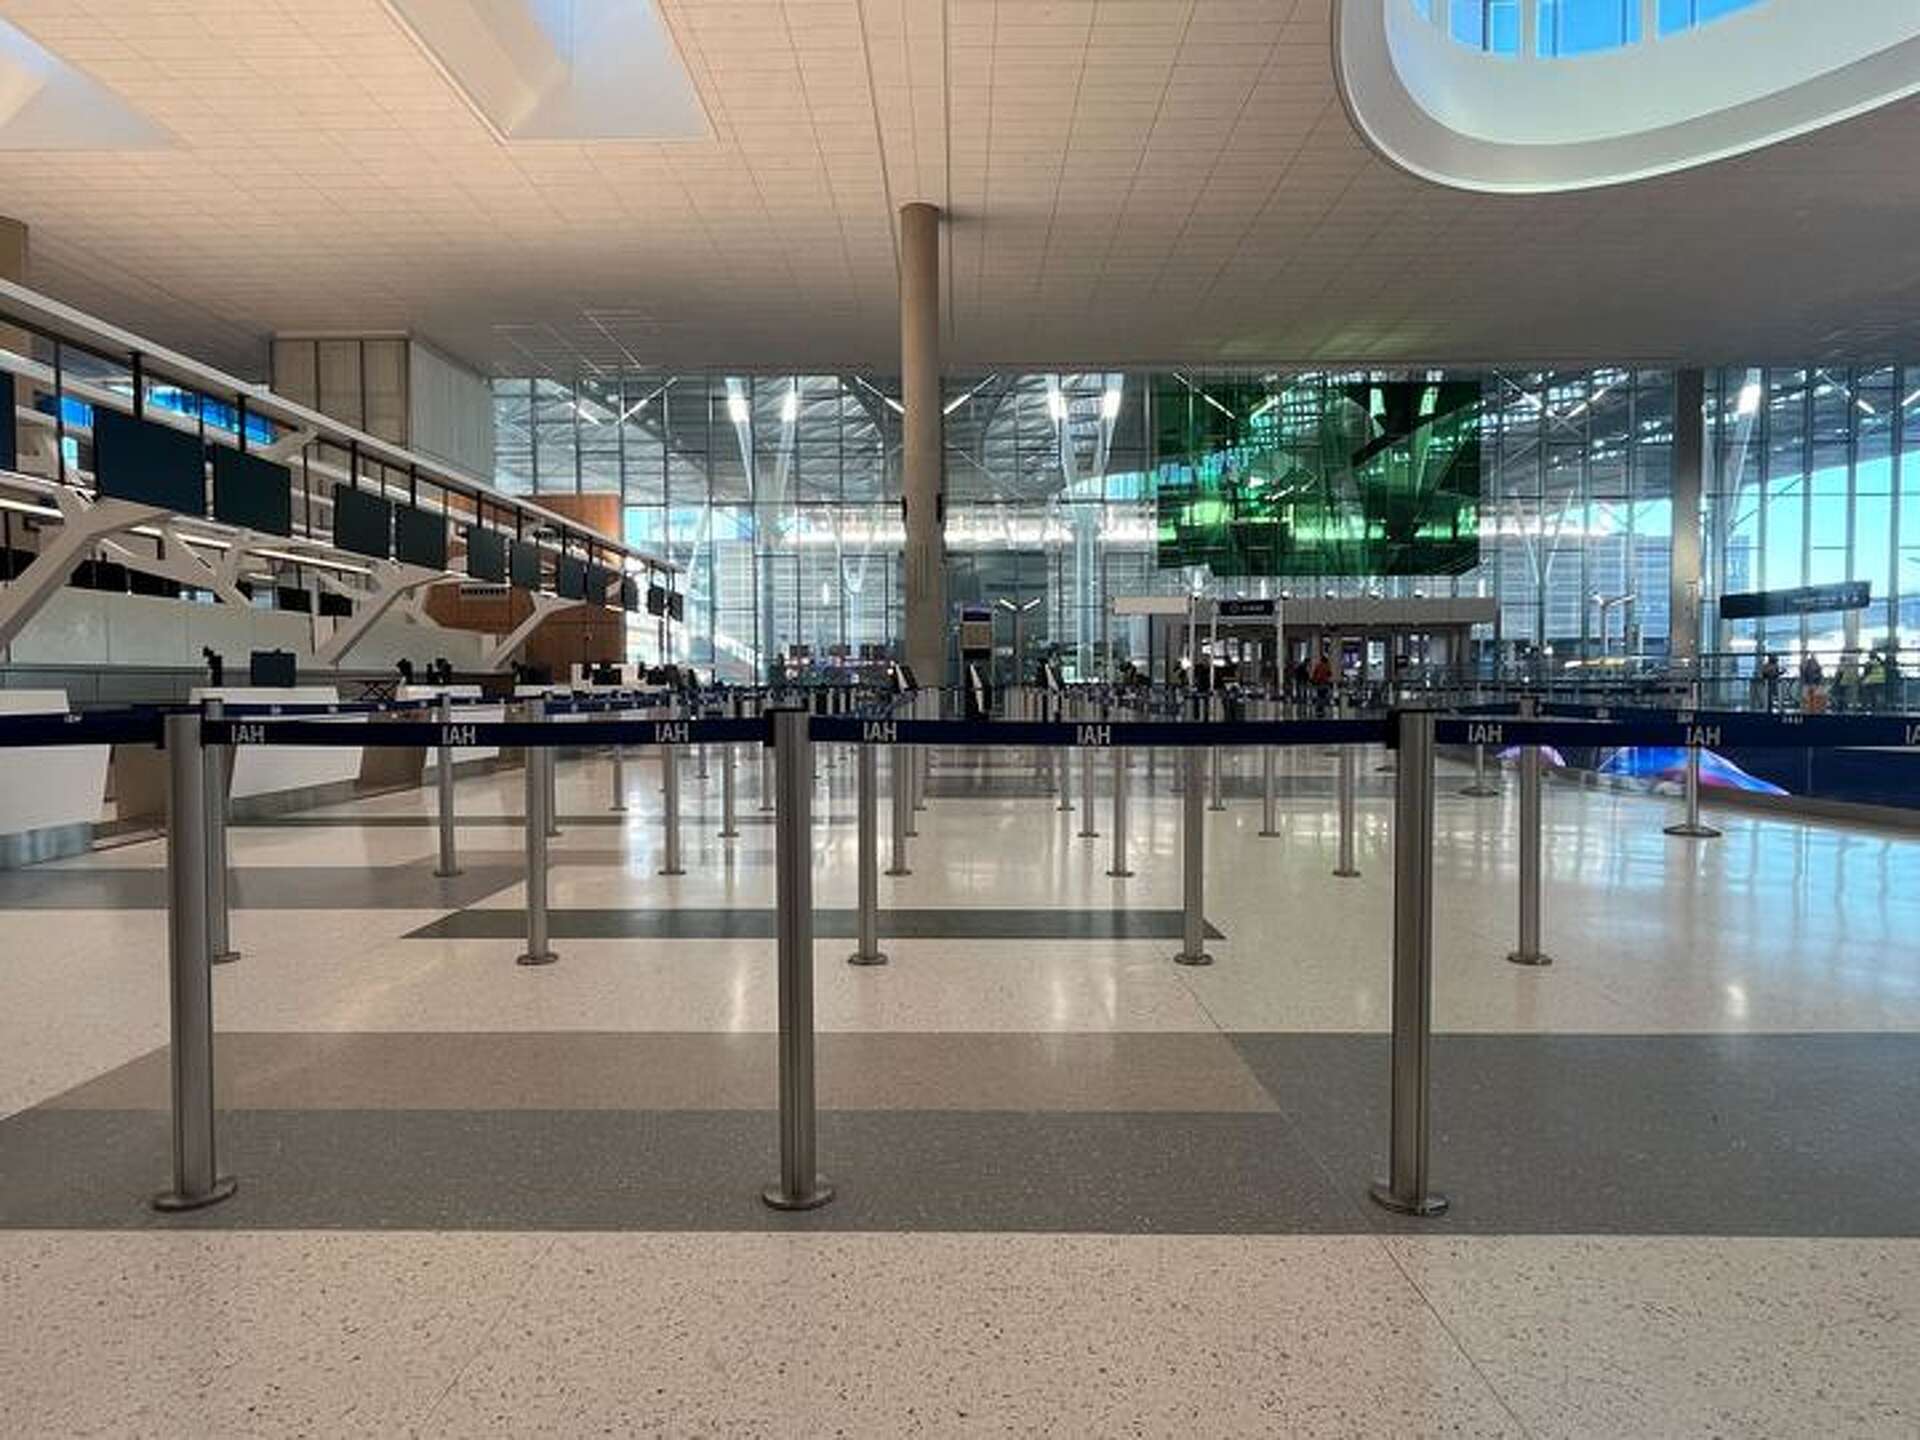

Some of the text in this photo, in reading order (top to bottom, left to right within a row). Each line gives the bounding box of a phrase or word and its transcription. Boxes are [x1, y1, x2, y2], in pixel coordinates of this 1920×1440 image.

[231, 724, 265, 744] IAH
[442, 725, 476, 745] IAH
[655, 722, 689, 742] IAH
[863, 722, 897, 742] IAH
[1077, 724, 1111, 745] IAH
[1468, 724, 1502, 743] IAH
[1686, 725, 1720, 745] IAH
[1905, 725, 1920, 744] IA
